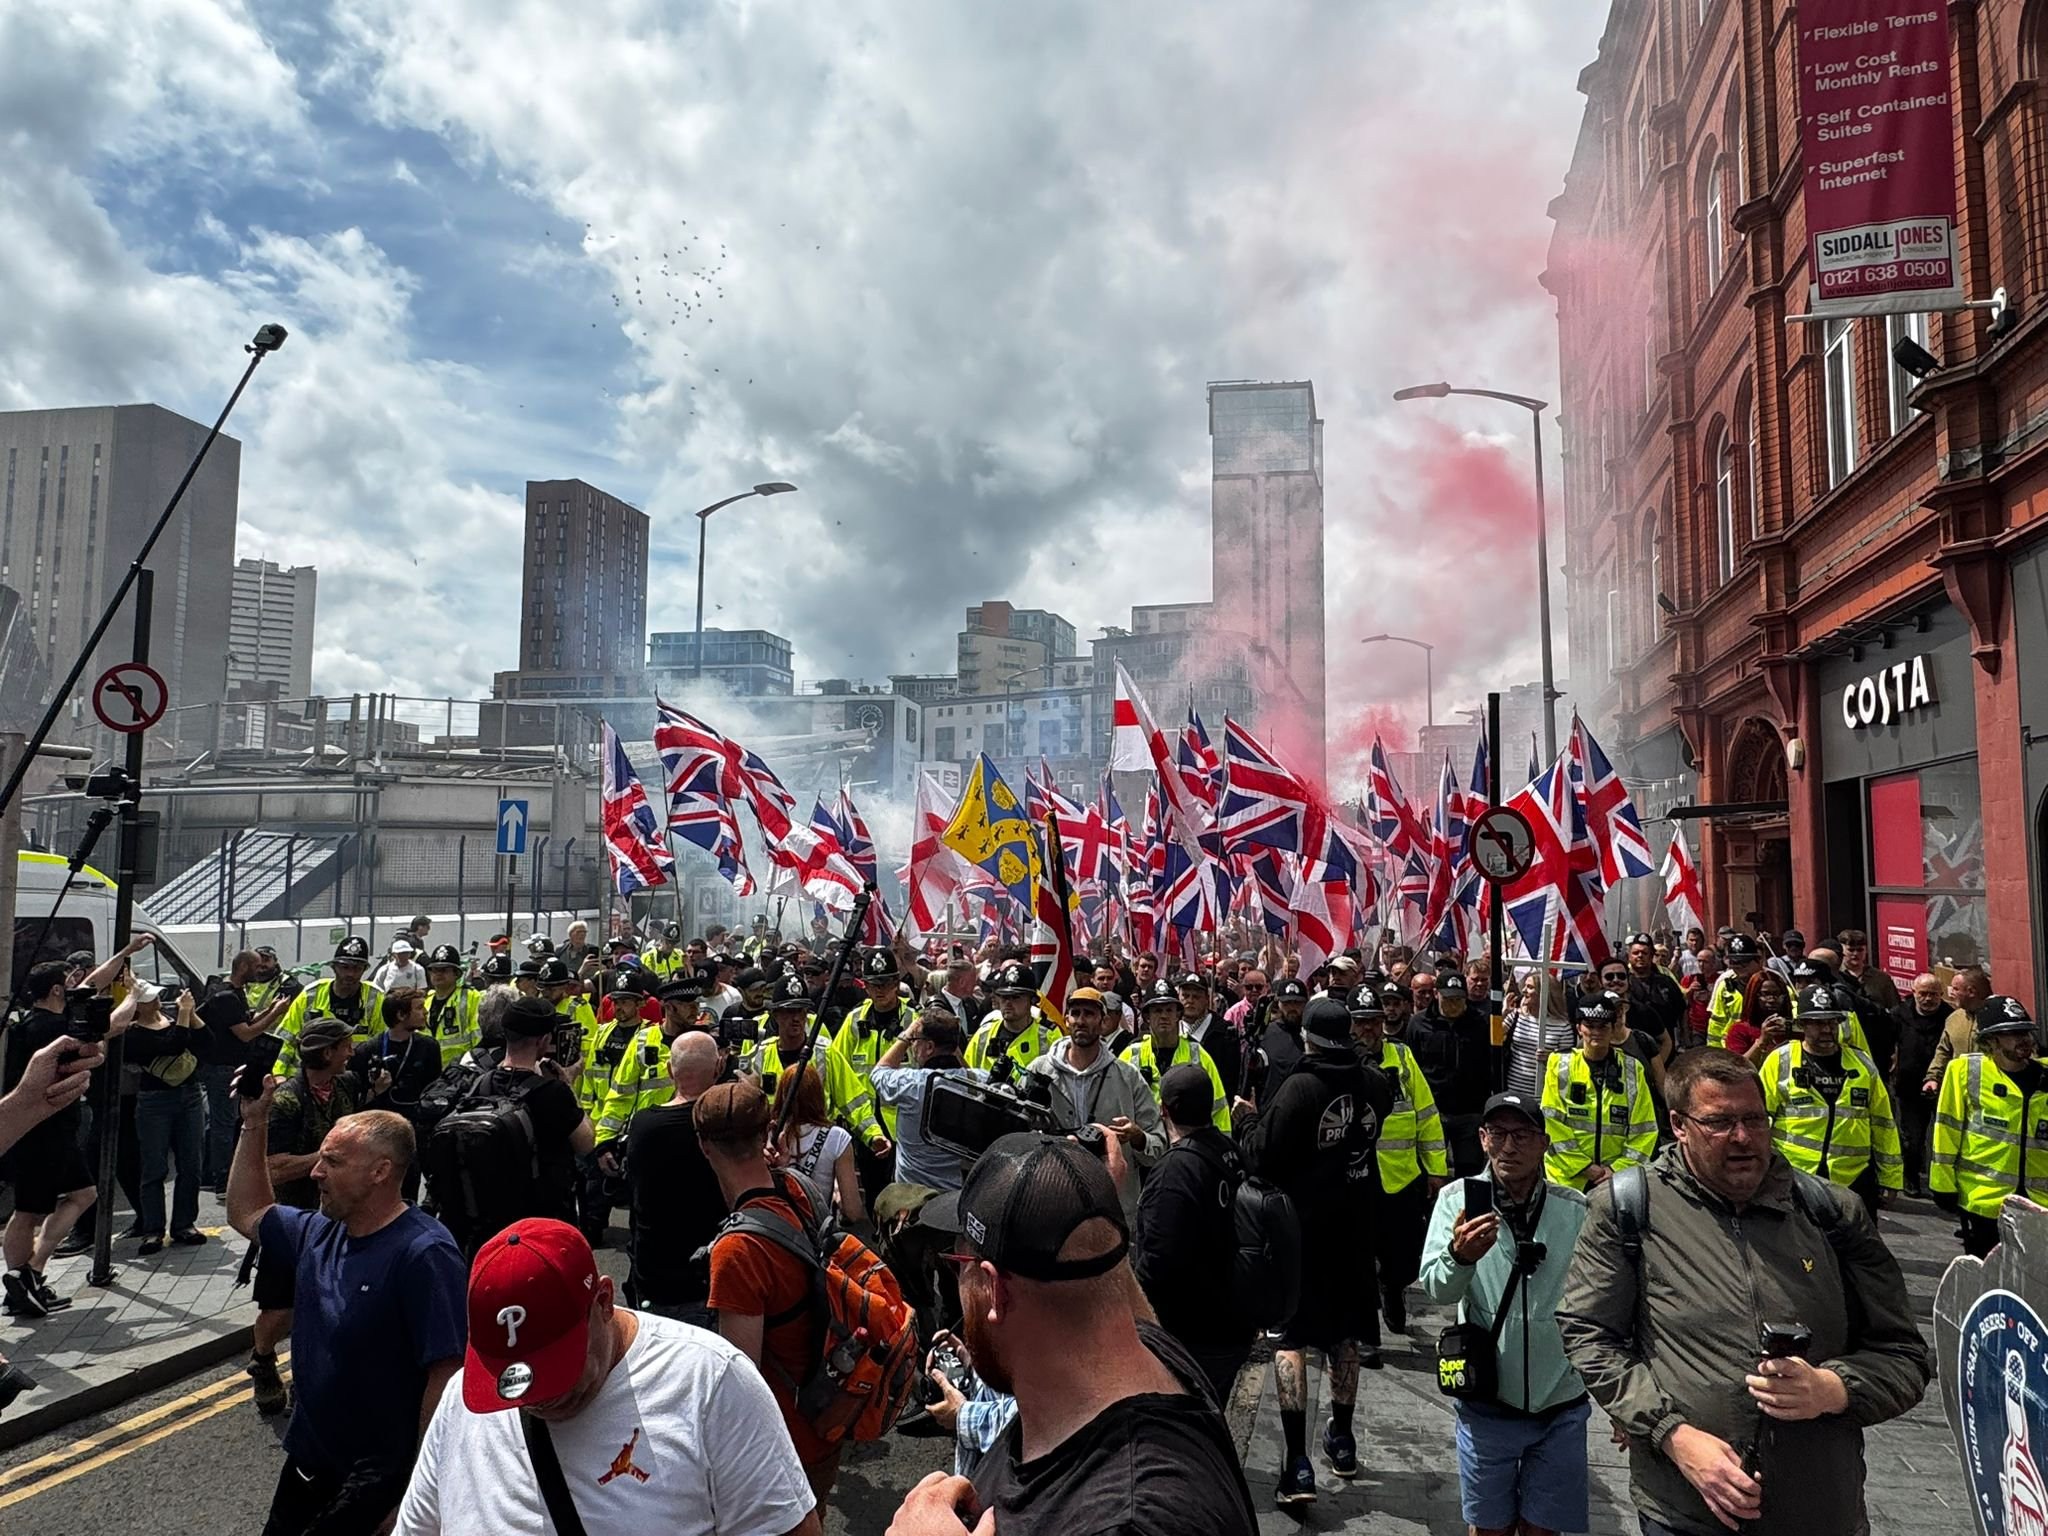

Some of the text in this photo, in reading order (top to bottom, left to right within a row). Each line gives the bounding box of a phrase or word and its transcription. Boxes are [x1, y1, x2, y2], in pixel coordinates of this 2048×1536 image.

[1814, 11, 1938, 40] Flexible Terms
[1815, 50, 1897, 75] Low Cost
[1816, 61, 1938, 91] Monthly Rents
[1817, 93, 1947, 125] Self Contained
[1818, 123, 1872, 141] Suites
[1819, 150, 1904, 174] Superfast
[1820, 167, 1887, 190] Internet
[1823, 226, 1943, 259] SIDDALL JONES
[1824, 261, 1946, 286] 0121 638 0500
[1826, 278, 1947, 296] www.siddalljones.com
[1843, 655, 1930, 729] COSTA
[809, 1128, 830, 1158] KARL
[497, 1305, 526, 1347] P
[1979, 1312, 2006, 1339] BEERS
[2017, 1321, 2039, 1352] OFF
[1440, 1358, 1466, 1375] Super
[1966, 1332, 1979, 1387] CRAFT
[1967, 1403, 1983, 1476] HOURS
